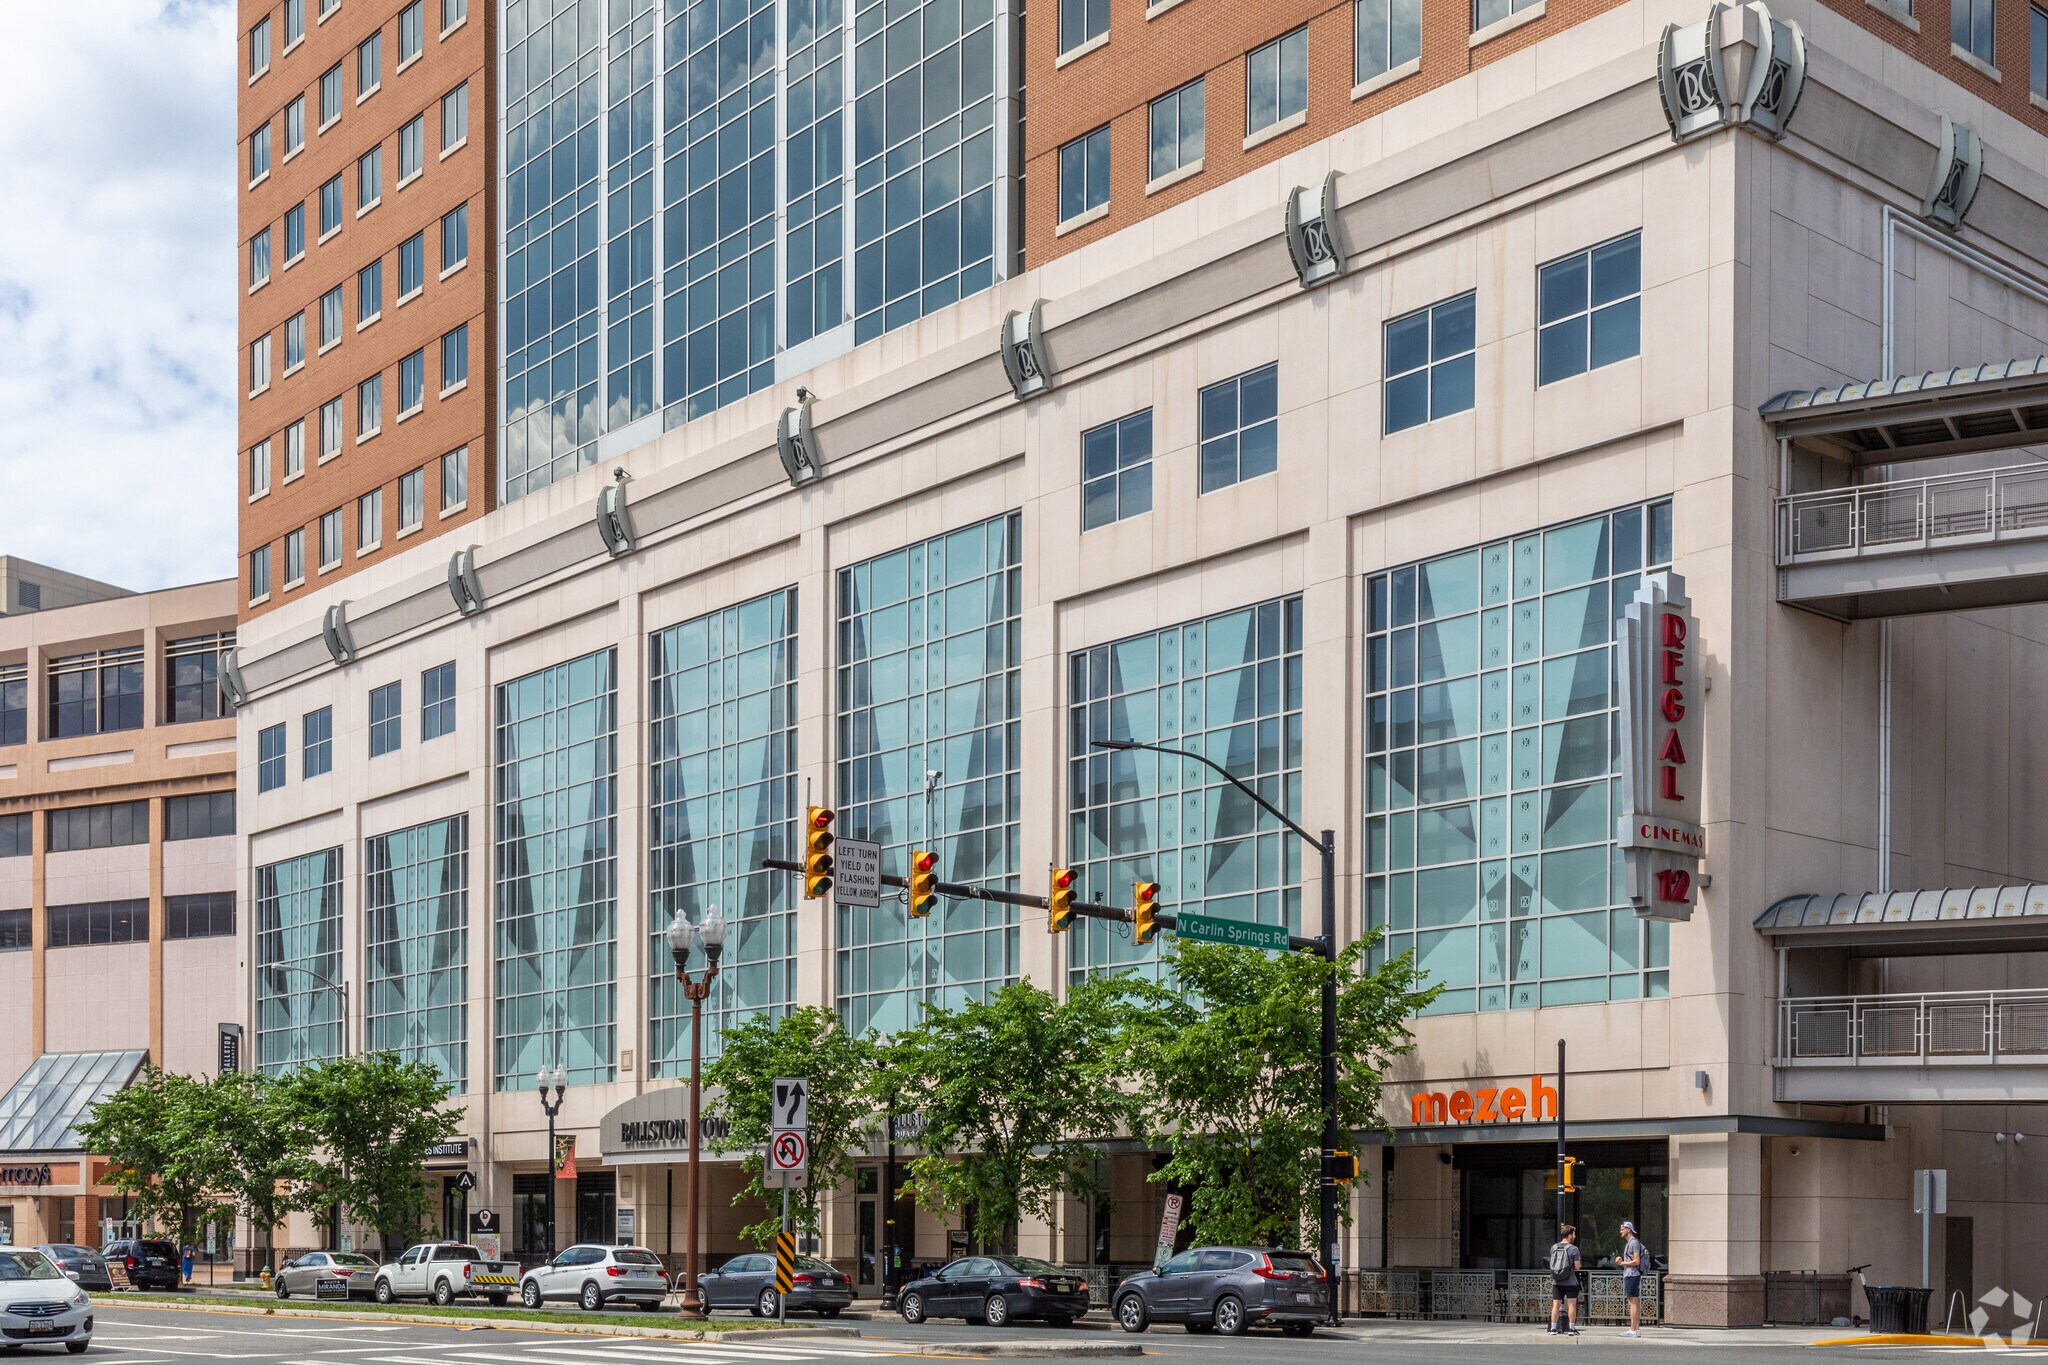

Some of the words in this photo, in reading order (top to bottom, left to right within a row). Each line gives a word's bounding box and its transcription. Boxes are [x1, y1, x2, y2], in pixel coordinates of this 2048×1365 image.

[1660, 612, 1687, 801] REGAL
[1640, 824, 1703, 849] CINEMAS
[838, 846, 855, 857] LEFT
[858, 848, 878, 860] TURN
[840, 859, 862, 871] YIELD
[864, 862, 875, 873] ON
[839, 872, 875, 886] FLASHING
[1655, 868, 1691, 904] 12
[836, 885, 858, 897] YELLOW
[858, 888, 878, 899] ARROW
[1178, 918, 1187, 932] N
[1190, 920, 1224, 937] Carlin
[1227, 925, 1270, 946] Springs
[1273, 931, 1288, 946] Rd
[1411, 1074, 1557, 1123] mezeh
[620, 1118, 687, 1143] BALLSTON
[433, 1143, 462, 1155] INSTITUTE
